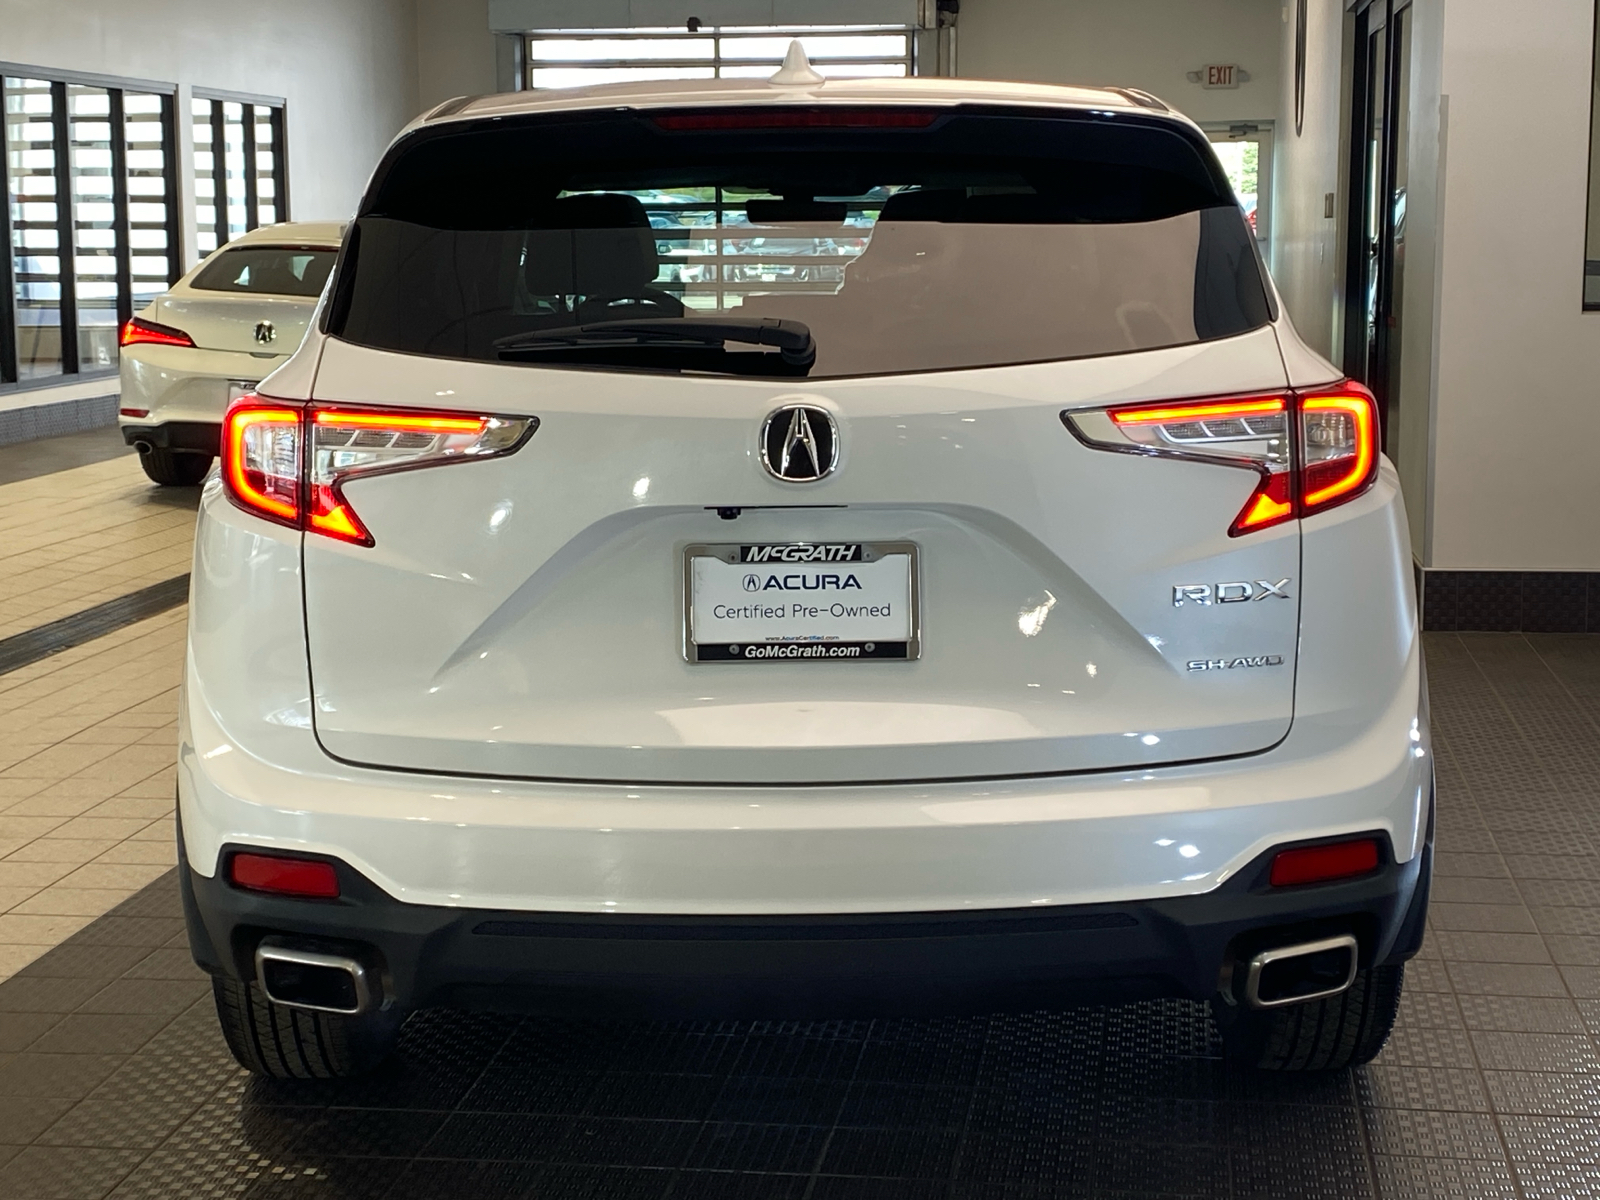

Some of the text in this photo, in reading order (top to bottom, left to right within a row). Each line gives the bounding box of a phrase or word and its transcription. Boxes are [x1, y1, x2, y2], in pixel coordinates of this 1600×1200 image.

[1208, 66, 1234, 85] EXIT
[762, 574, 863, 591] ACURA
[1172, 578, 1291, 607] RDX
[713, 603, 891, 619] Certified Pre-Owned
[744, 643, 861, 659] GoMcGrath.com
